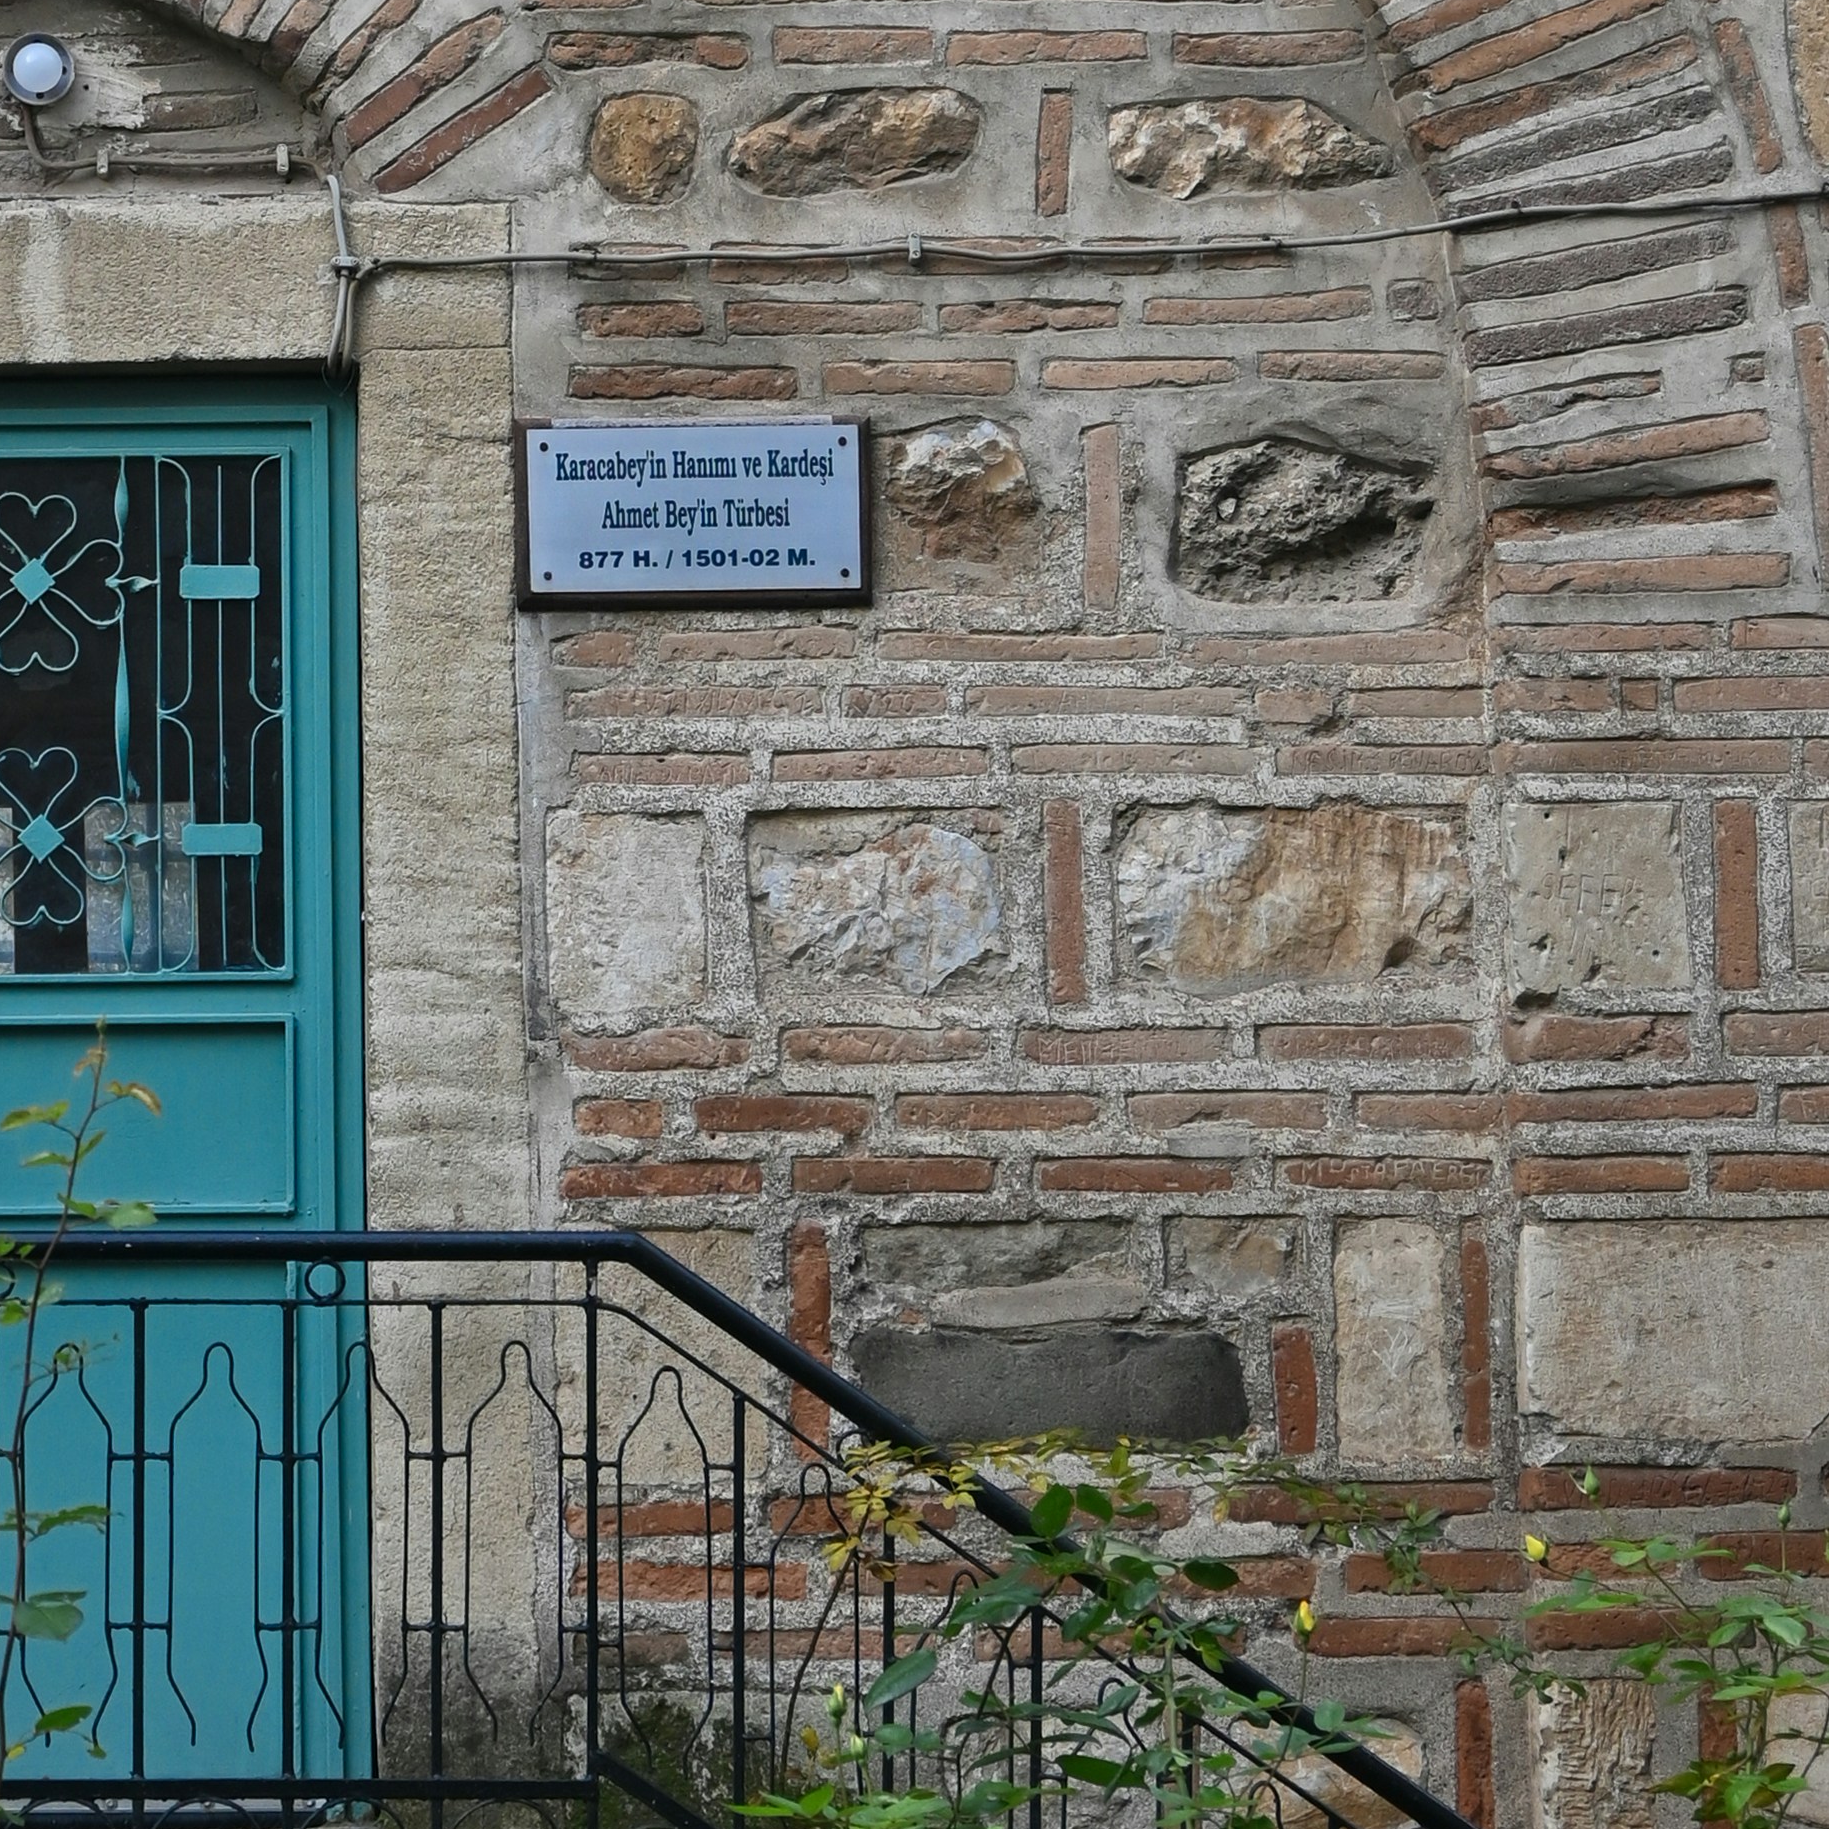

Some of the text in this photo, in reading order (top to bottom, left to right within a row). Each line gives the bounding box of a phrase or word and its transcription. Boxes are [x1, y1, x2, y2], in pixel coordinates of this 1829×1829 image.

[555, 448, 834, 487] Karacabey'in Hanımı ve Kardeşi
[602, 498, 790, 535] Ahmet Bey'in Türbesi
[579, 548, 815, 569] 877 H. / 1501-02 M.
